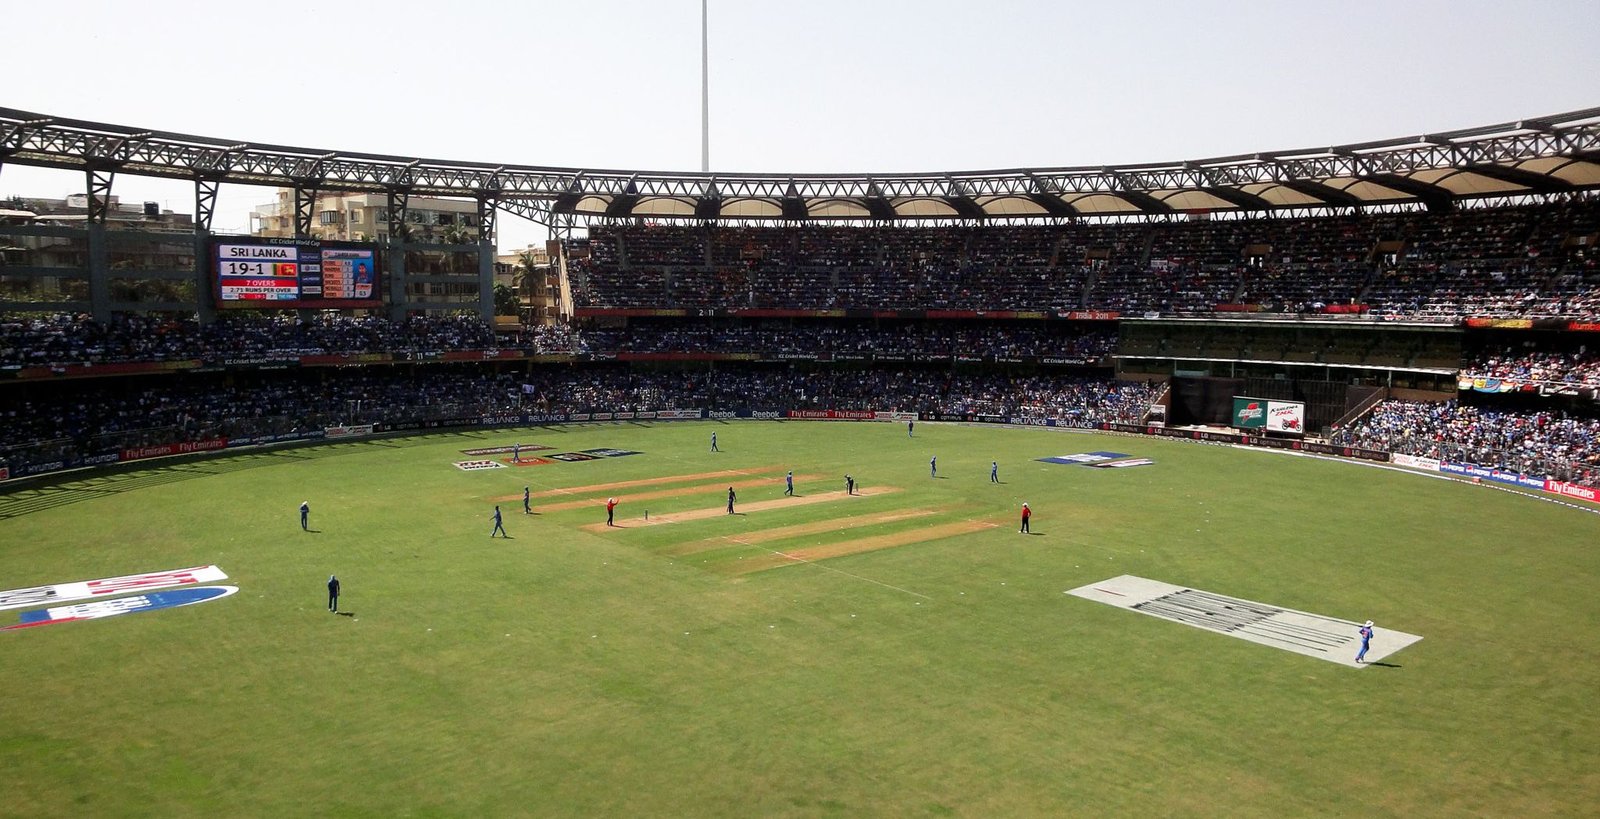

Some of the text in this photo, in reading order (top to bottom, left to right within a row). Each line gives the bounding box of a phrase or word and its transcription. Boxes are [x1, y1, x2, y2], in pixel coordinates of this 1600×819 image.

[230, 248, 287, 258] SRI LANKA
[229, 263, 264, 275] 19-1
[709, 410, 736, 418] Reebok
[752, 410, 780, 418] Reebok
[792, 410, 802, 418] Fly
[179, 440, 223, 452] Fly Emirates
[126, 446, 171, 460] Fly Emirates
[84, 453, 119, 464] HYUNDAI
[28, 461, 64, 472] HYUNDAI
[1500, 473, 1517, 481] PEPSI
[1527, 478, 1544, 487] PEPSI
[1550, 481, 1595, 499] Fly Emirates
